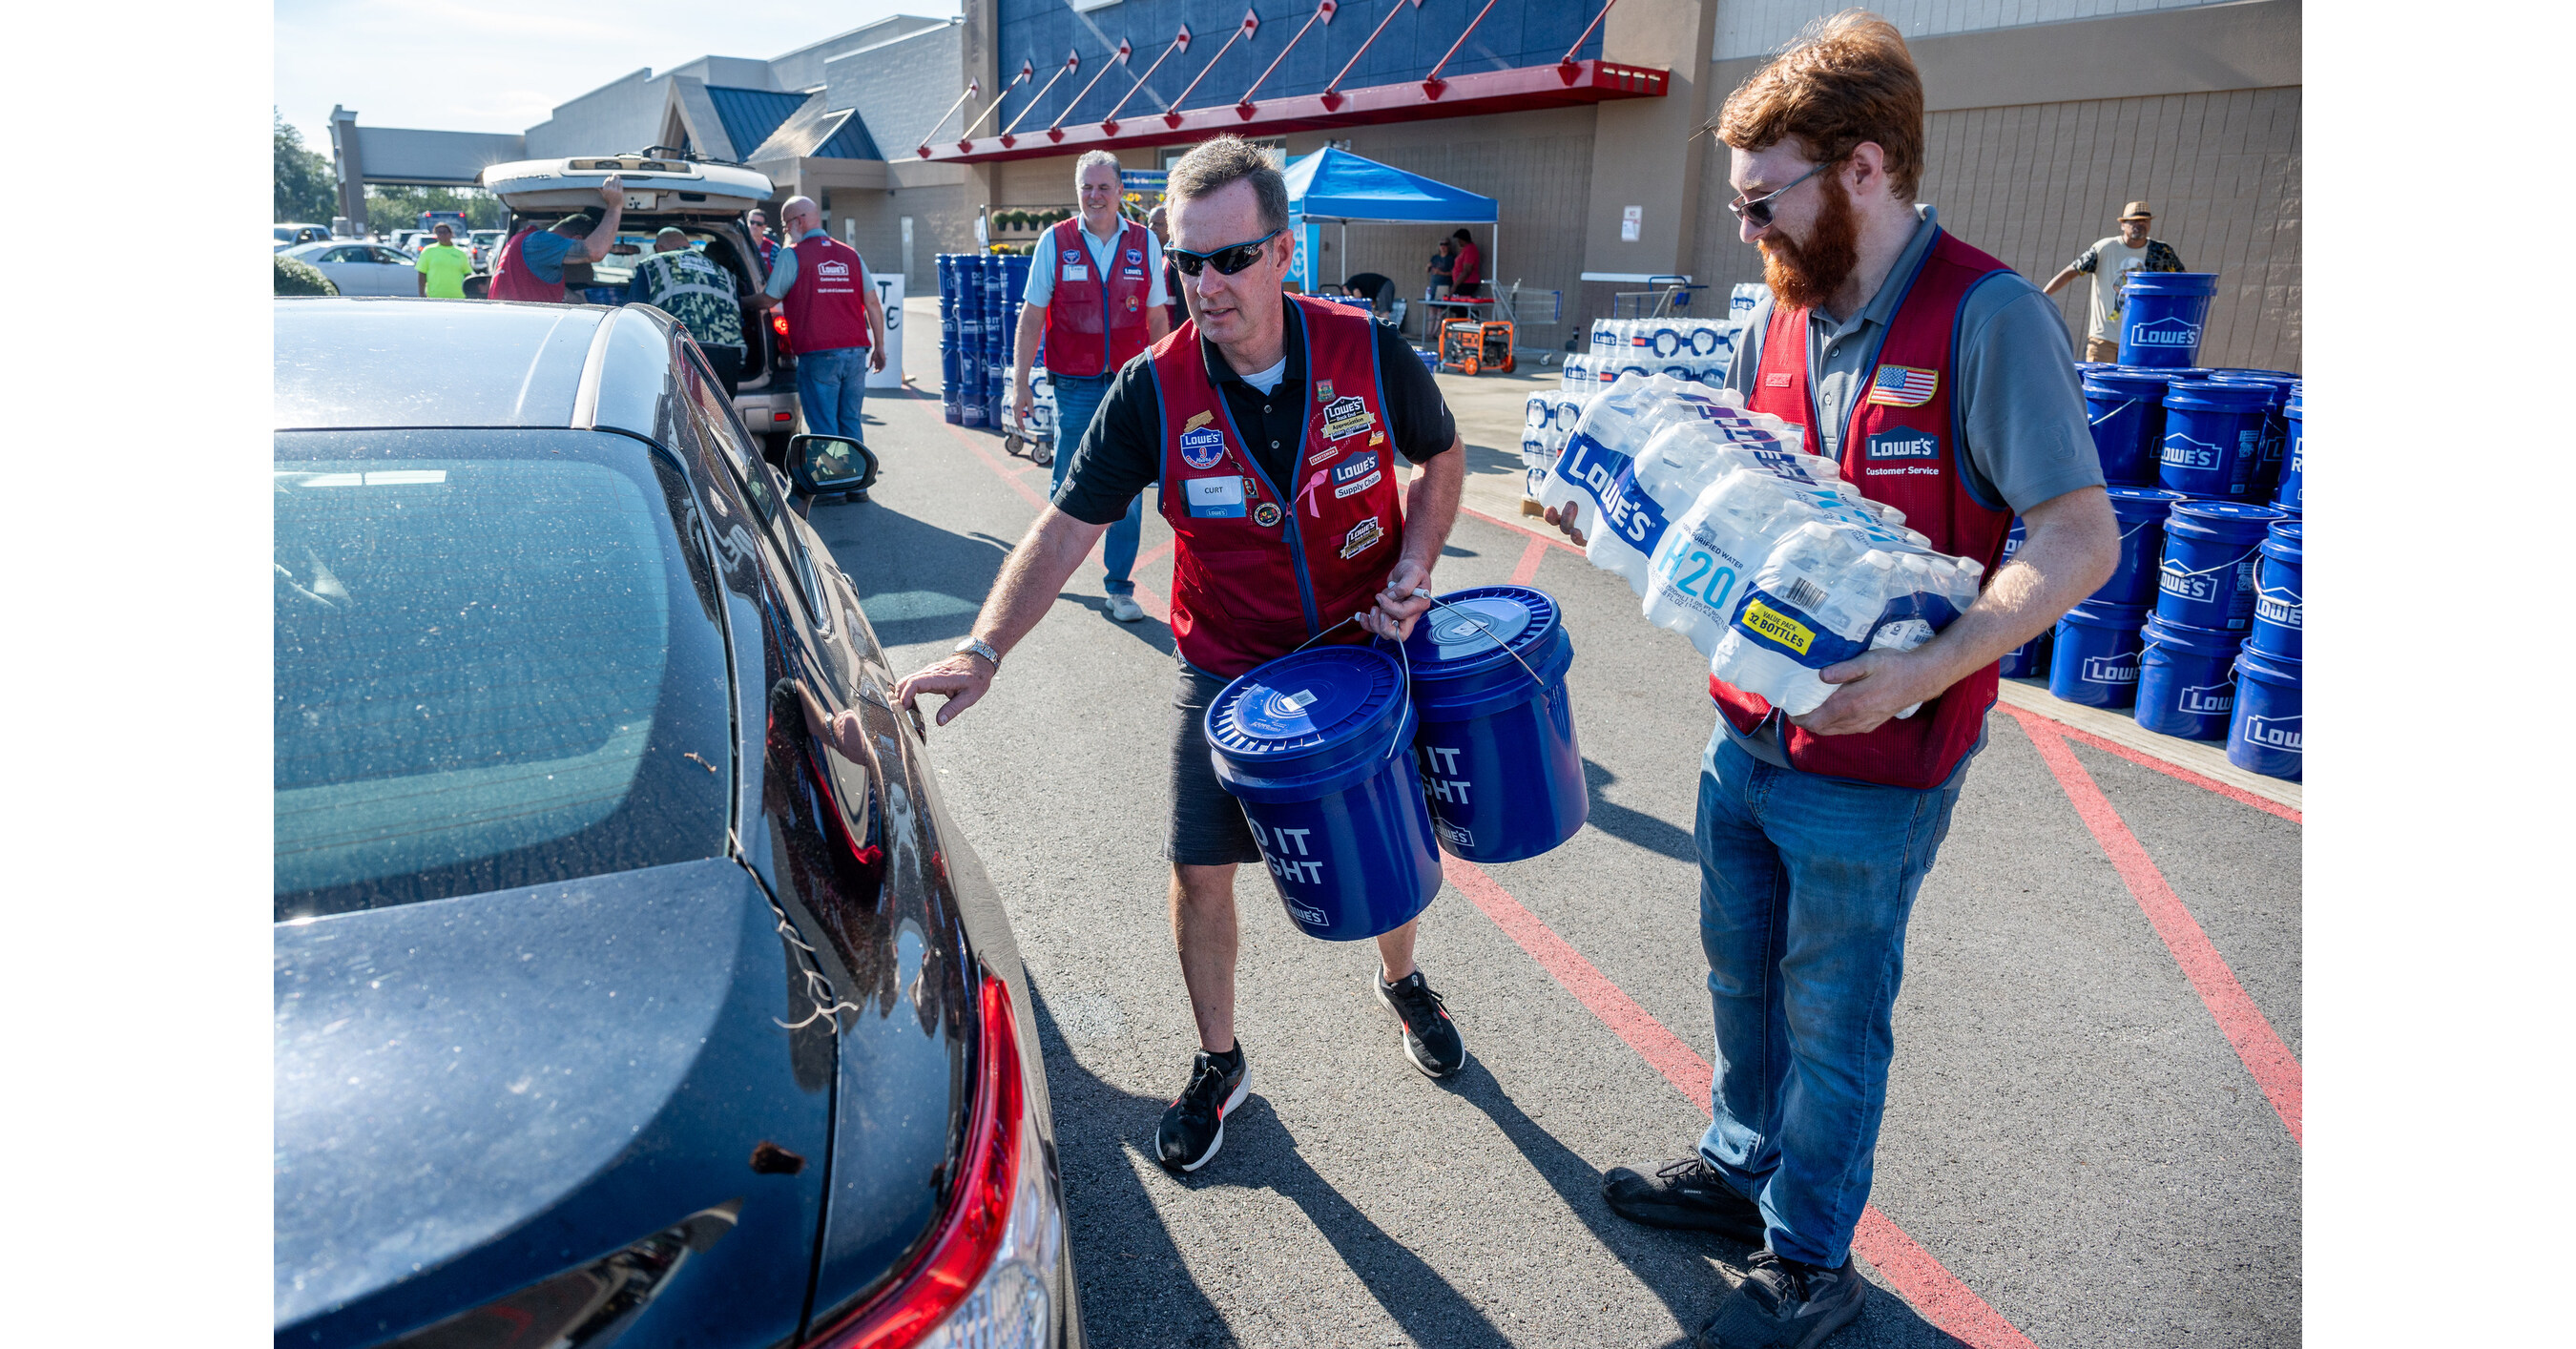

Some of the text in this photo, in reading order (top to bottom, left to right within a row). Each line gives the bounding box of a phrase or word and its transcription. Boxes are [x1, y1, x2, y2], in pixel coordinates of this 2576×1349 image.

[821, 265, 845, 274] LOWE'S
[2138, 328, 2196, 344] LOWE'S
[1328, 401, 1361, 418] LOWE'S
[1185, 432, 1220, 446] LOWE'S
[1871, 438, 1934, 456] LOWE'S
[1198, 446, 1207, 458] 9
[1312, 448, 1336, 463] CRAFTSMAN
[1336, 456, 1376, 481] LOWE'S
[1866, 466, 1939, 476] Customer Service
[1204, 486, 1223, 494] CURT
[1338, 474, 1380, 497] Supply Chain
[1568, 445, 1652, 542] LOWE'S
[1691, 530, 1722, 556] PURIFIED
[1721, 550, 1744, 571] WATER
[2255, 595, 2302, 625] LOWE
[1748, 612, 1760, 626] 32
[1759, 618, 1805, 649] BOTTLES
[1762, 611, 1797, 633] VALUE PACK
[1425, 745, 1461, 776] IT
[1421, 774, 1471, 805] GHT
[1273, 826, 1311, 856] IT
[1264, 851, 1323, 884] GHT
